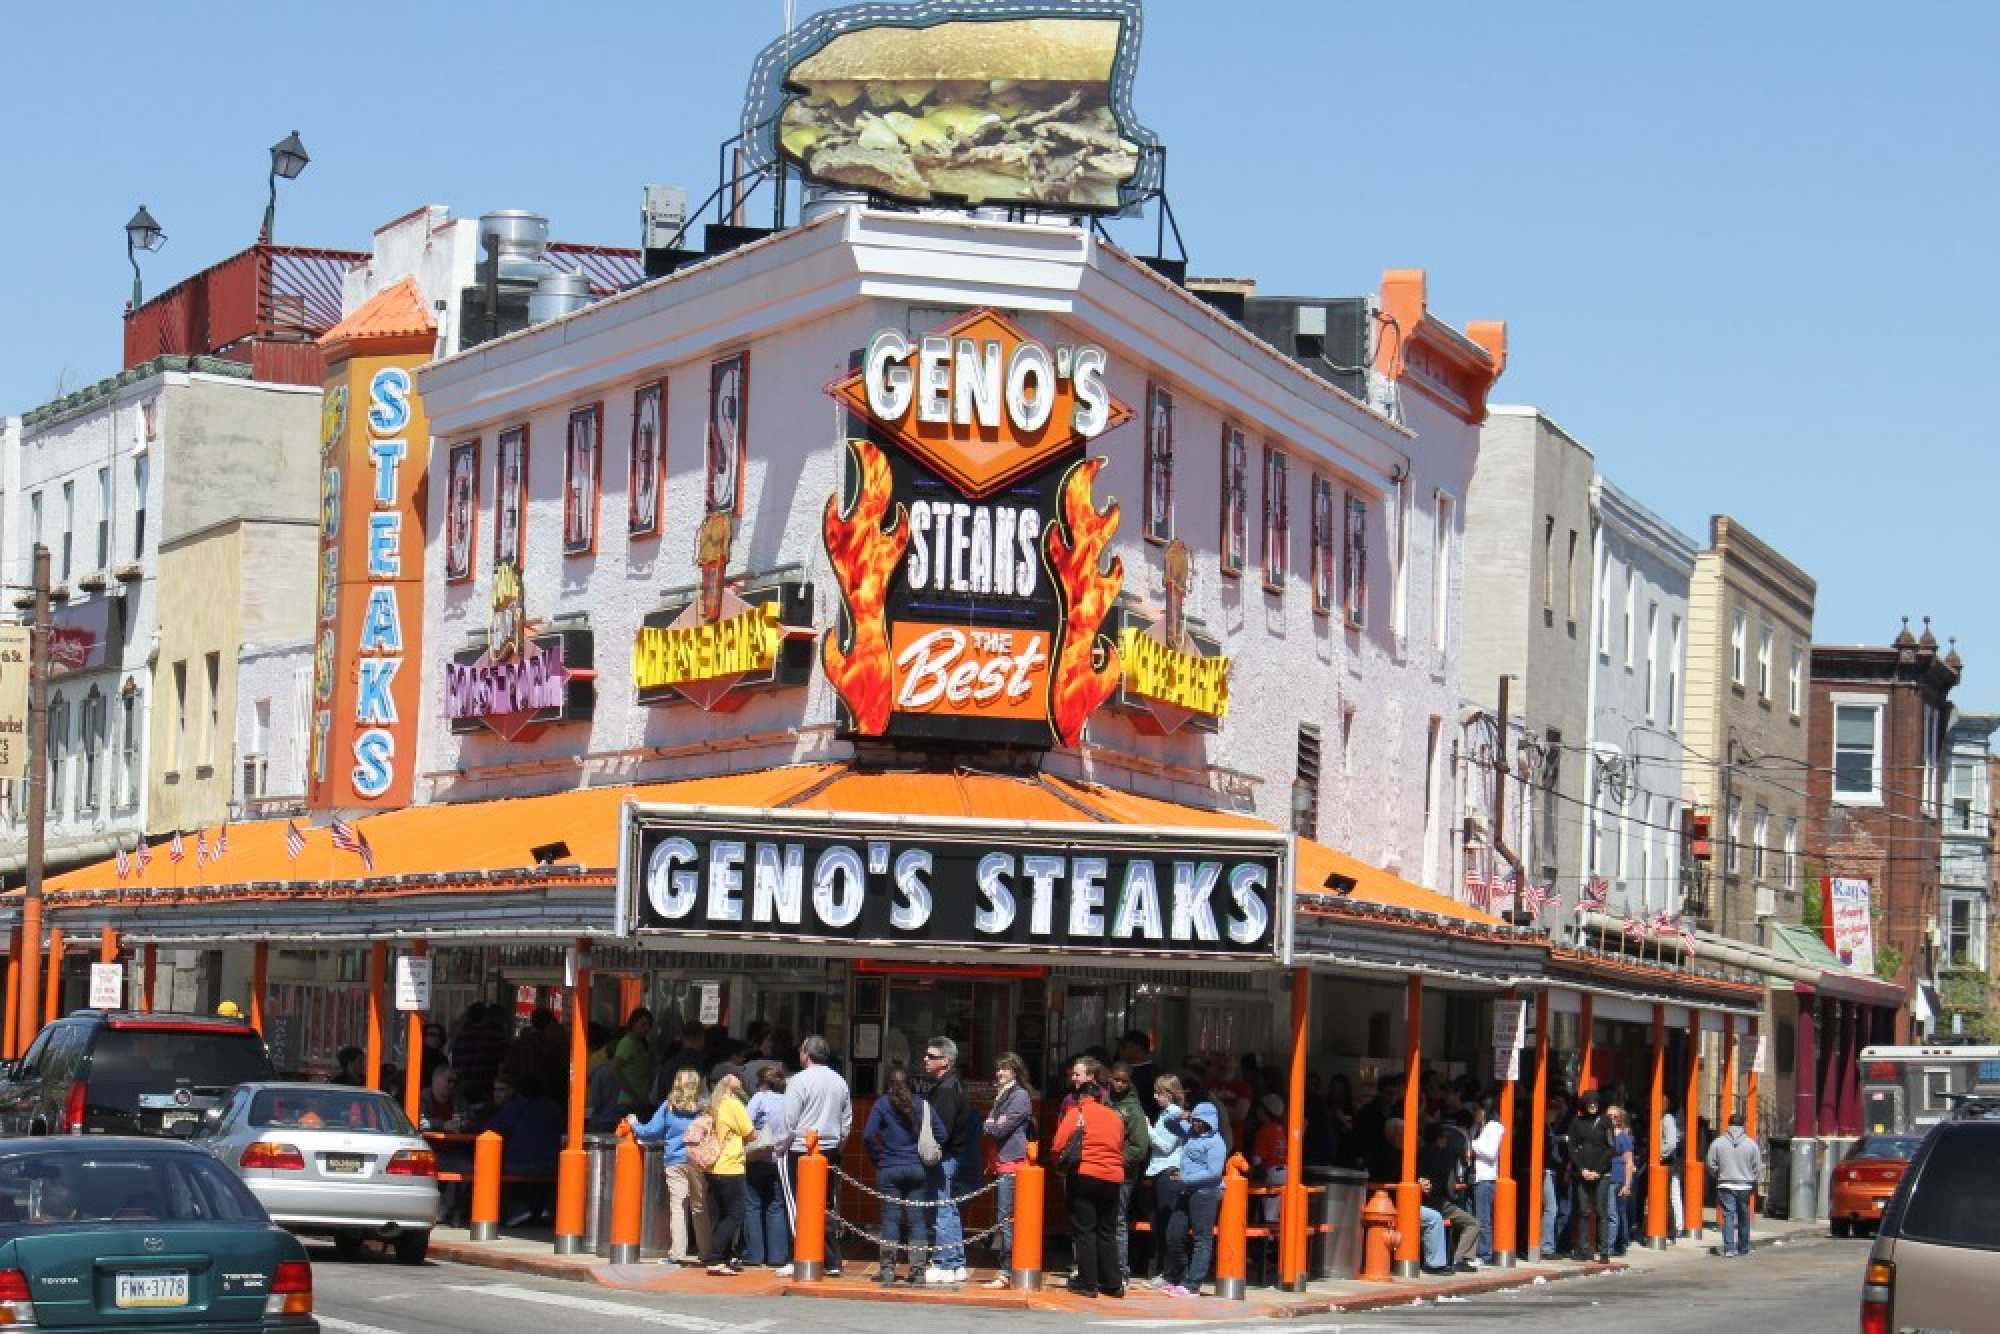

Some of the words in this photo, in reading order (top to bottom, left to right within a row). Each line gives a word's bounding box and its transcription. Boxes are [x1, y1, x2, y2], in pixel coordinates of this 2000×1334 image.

[865, 329, 1109, 437] GENO'S
[353, 367, 412, 797] STEAKS
[907, 500, 1041, 597] STEAKS
[896, 628, 1047, 708] Best
[971, 632, 1013, 653] THE
[646, 836, 934, 931] GENO'S
[974, 851, 1270, 946] STEAKS
